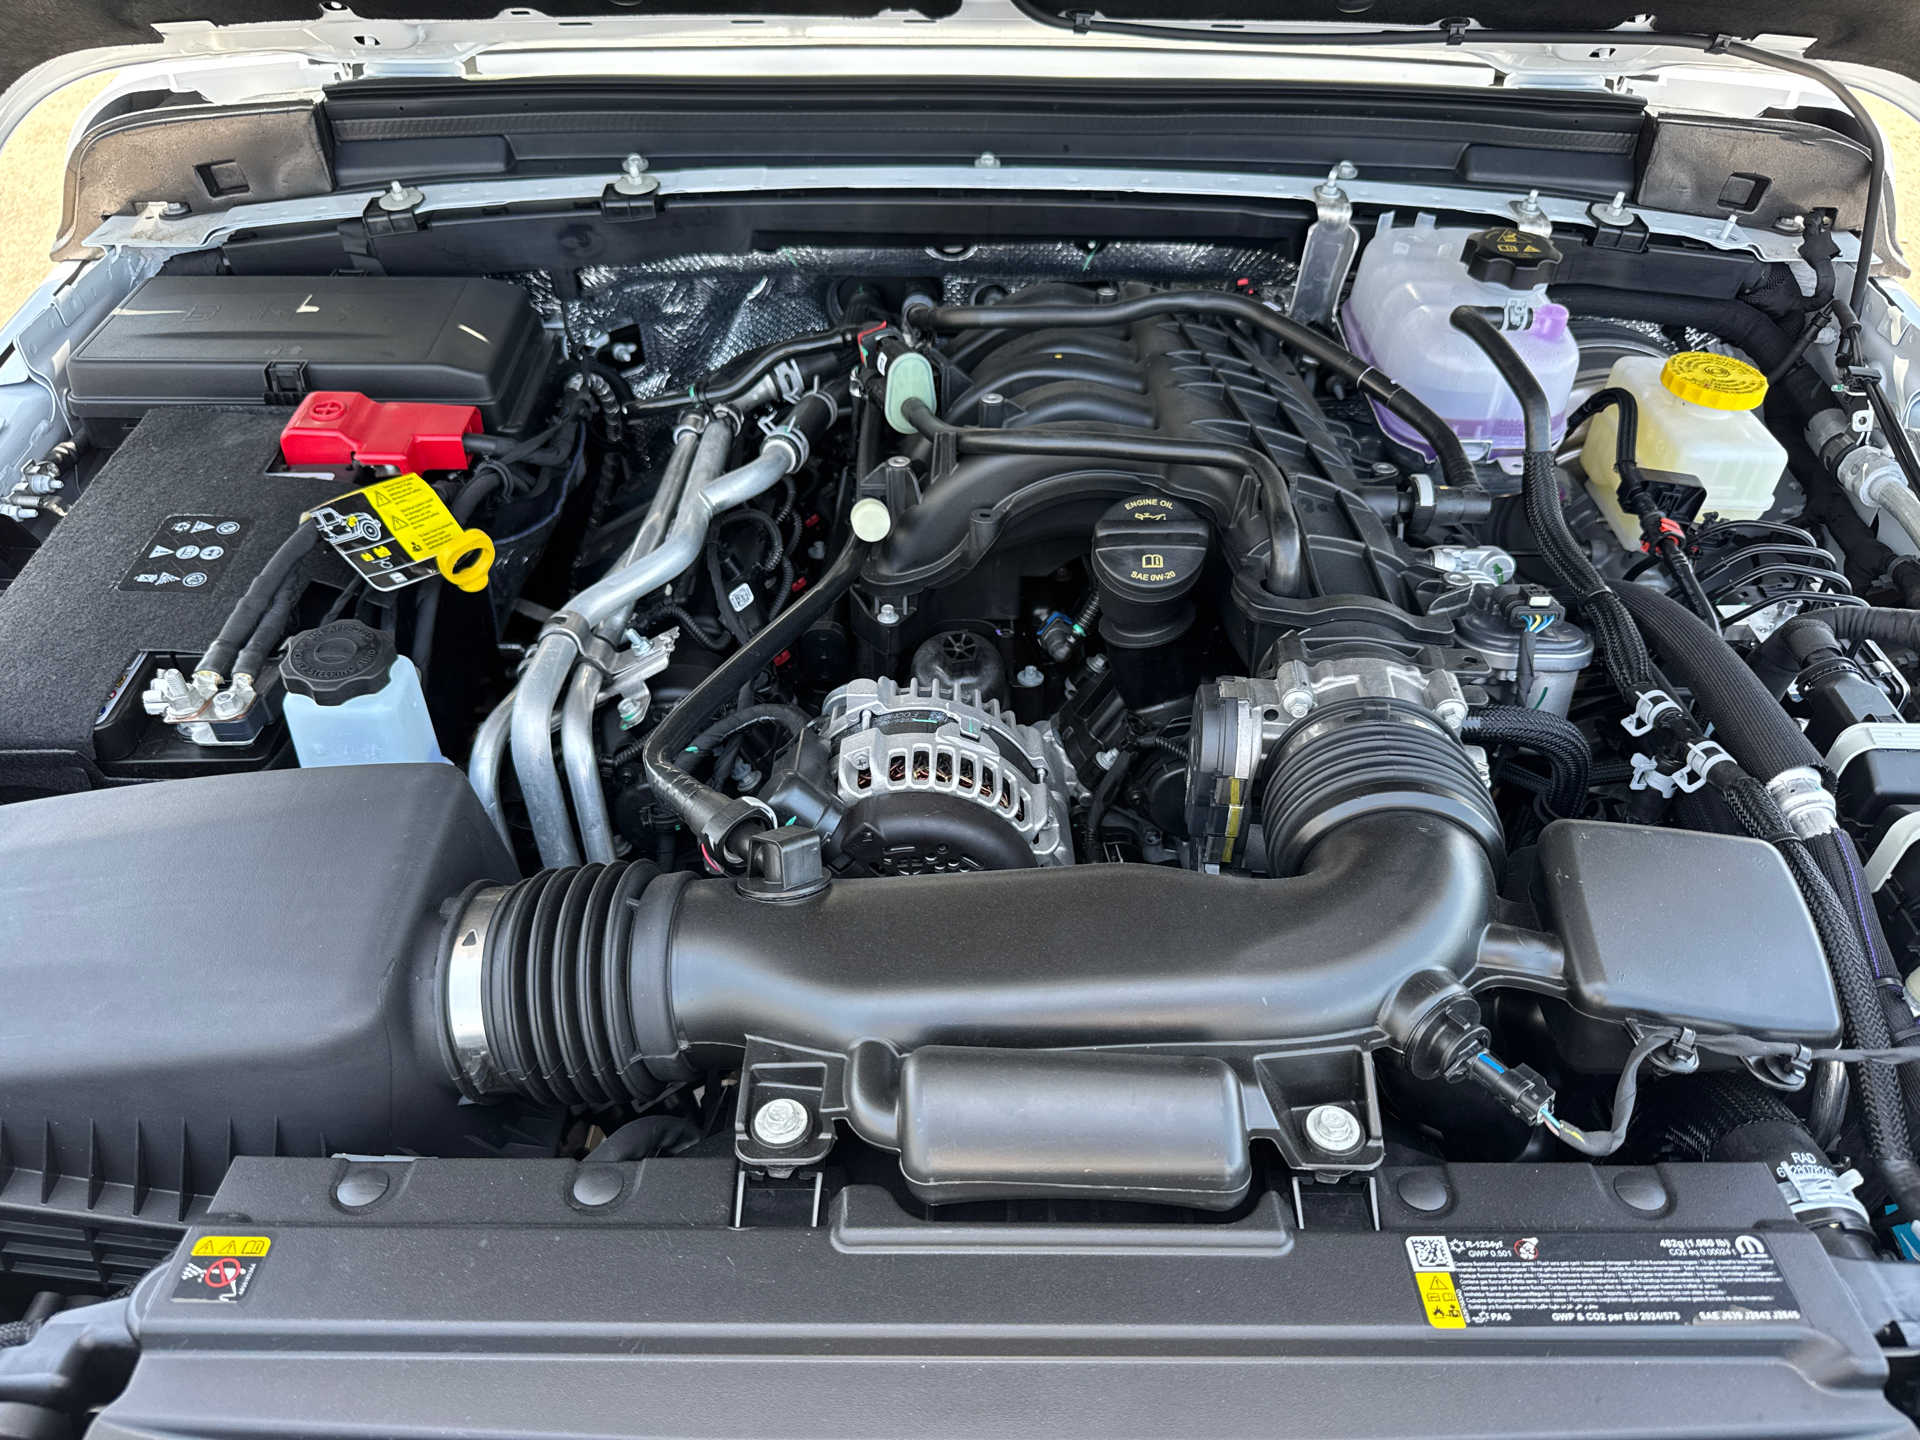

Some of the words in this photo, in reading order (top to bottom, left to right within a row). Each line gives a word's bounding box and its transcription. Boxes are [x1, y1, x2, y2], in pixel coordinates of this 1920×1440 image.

[1124, 499, 1158, 510] ENGINE
[1159, 500, 1174, 510] OIL
[1130, 571, 1149, 581] SAE
[1150, 571, 1176, 581] 0W-20
[305, 629, 325, 640] USE
[328, 624, 375, 640] APPROVED
[293, 648, 310, 674] POWER
[307, 665, 356, 678] STEERING
[356, 648, 377, 669] FLUID
[1790, 1152, 1817, 1164] RAD
[1659, 1239, 1684, 1249] 482g
[1715, 1239, 1731, 1249] lb)
[1467, 1250, 1489, 1258] GWP
[1668, 1248, 1688, 1256] CO2
[1688, 1249, 1700, 1257] eq
[1490, 1312, 1512, 1321] PAG
[1551, 1312, 1576, 1321] GWP
[1576, 1312, 1585, 1321] &
[1585, 1312, 1607, 1321] CO2
[1607, 1313, 1623, 1322] per
[1623, 1312, 1639, 1321] EU
[1699, 1311, 1720, 1320] SAE
